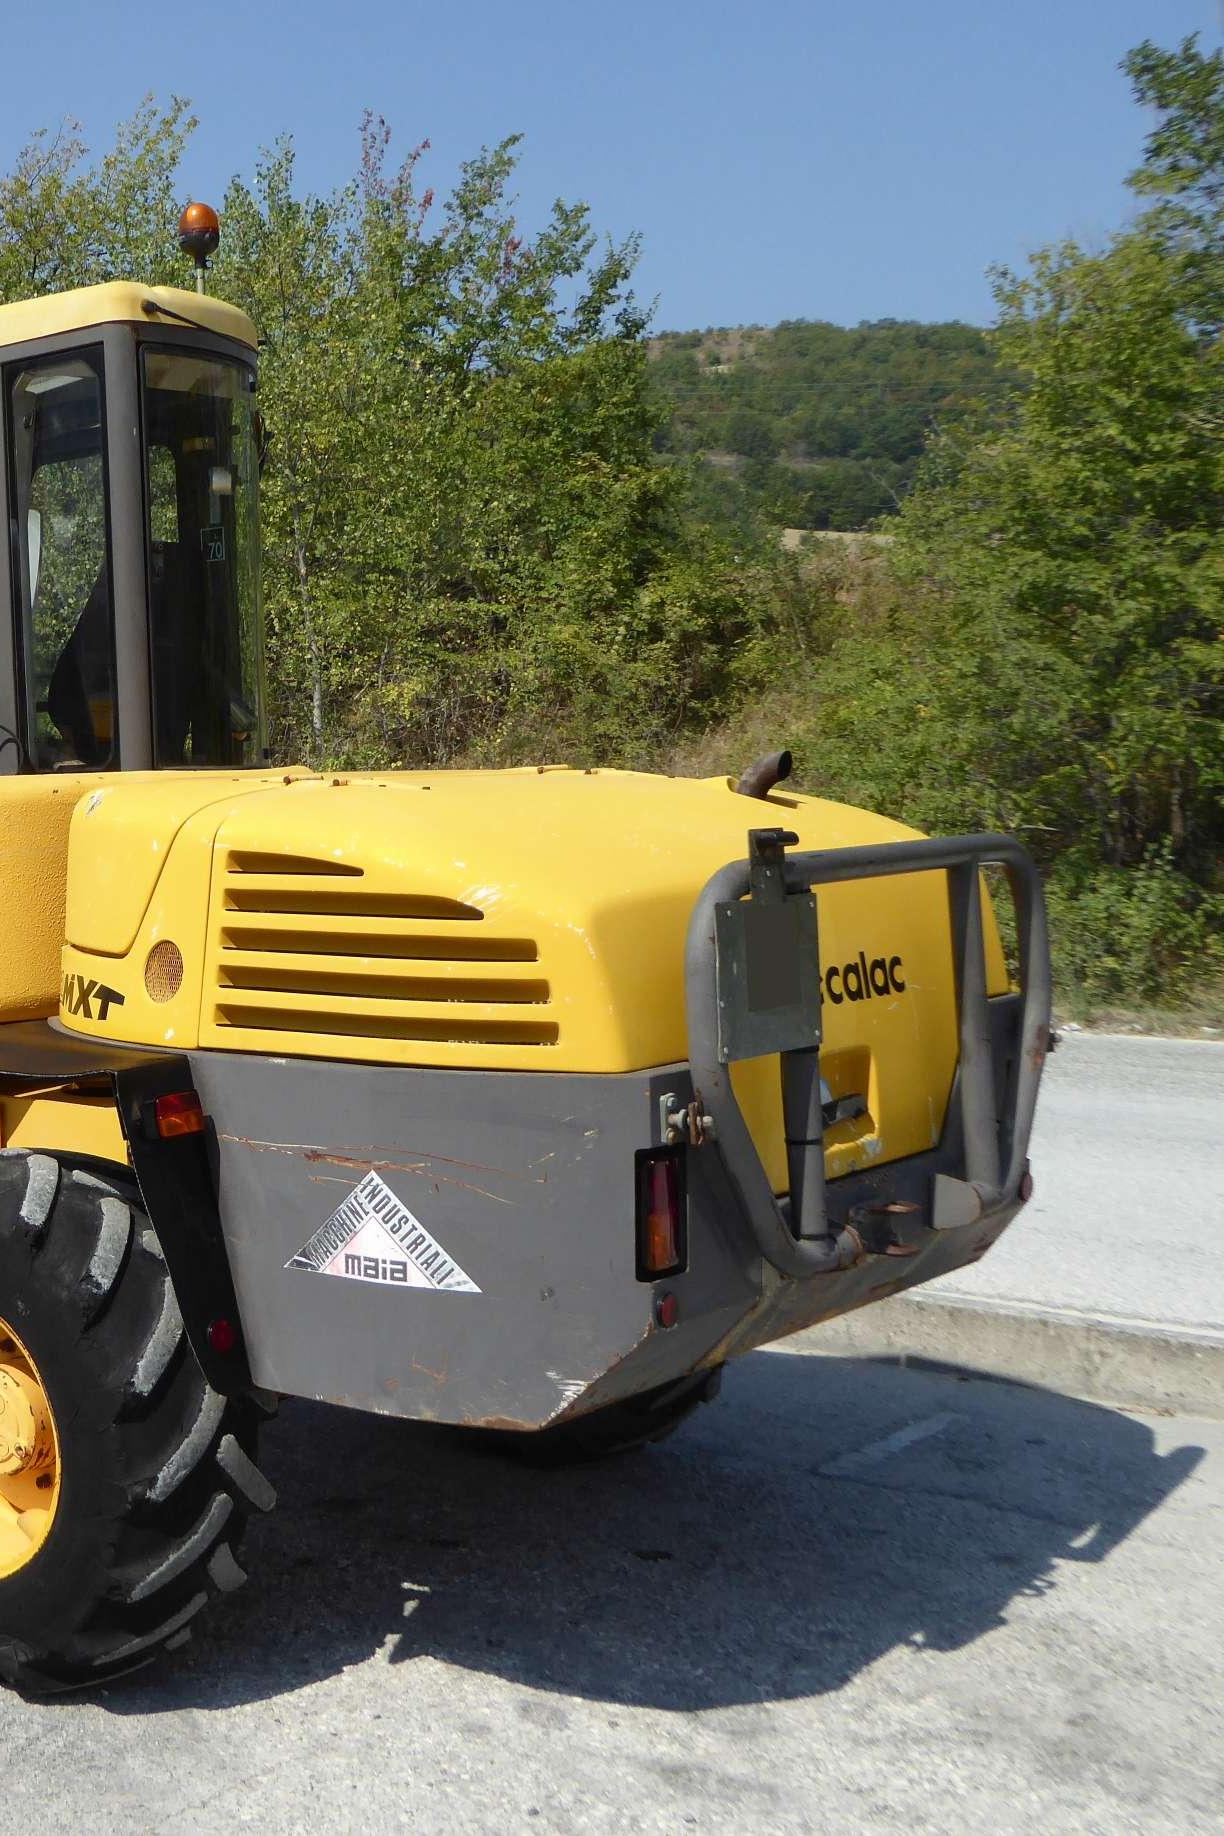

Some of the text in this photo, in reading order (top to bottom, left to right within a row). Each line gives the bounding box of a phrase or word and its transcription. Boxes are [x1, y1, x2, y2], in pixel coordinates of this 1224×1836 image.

[820, 951, 905, 1004] calac
[308, 1195, 370, 1271] MACCHINE
[361, 1177, 455, 1285] INDUSTRIALI
[344, 1253, 408, 1282] maia
